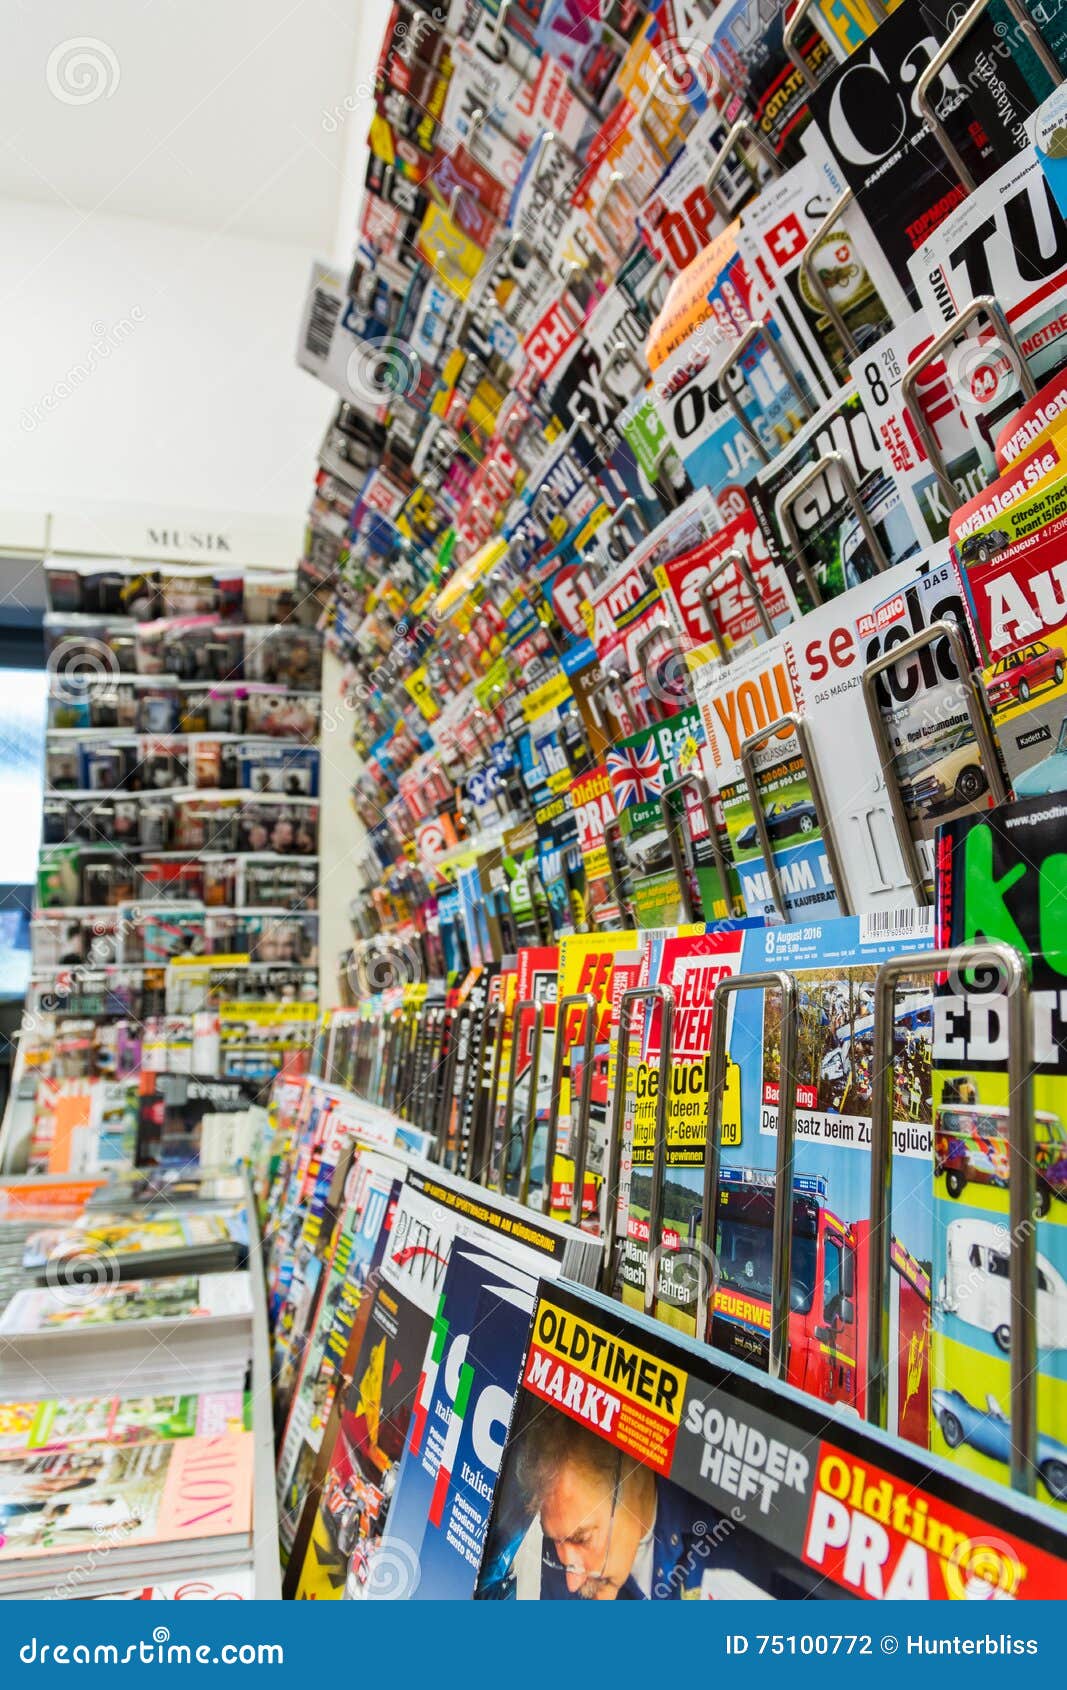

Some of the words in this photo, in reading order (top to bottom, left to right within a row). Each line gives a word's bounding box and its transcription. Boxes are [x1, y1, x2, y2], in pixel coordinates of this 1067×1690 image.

[881, 348, 896, 366] 20
[887, 363, 902, 379] 16
[864, 362, 890, 407] 8
[955, 478, 1028, 541] Wählen
[1023, 453, 1057, 489] Sie
[1011, 502, 1046, 526] Citroën
[1015, 515, 1042, 538] Avant
[147, 528, 232, 552] MUSIK
[990, 533, 1041, 567] JULI/AUGUST
[922, 569, 950, 591] DAS
[805, 627, 857, 681] se
[815, 692, 830, 705] DAS
[720, 786, 735, 801] 911
[632, 805, 650, 823] Cars
[764, 931, 775, 955] 8
[776, 930, 802, 947] August
[802, 926, 823, 941] 2016
[931, 989, 1067, 1064] EDI
[669, 1100, 700, 1118] Ideen
[824, 1118, 854, 1142] beim
[500, 1218, 512, 1232] AM
[511, 1221, 557, 1254] NÜRBURGRING
[538, 1309, 679, 1416] OLDTIMER
[526, 1351, 621, 1433] MARKT
[684, 1398, 810, 1496] SONDER
[700, 1441, 780, 1515] HEFT
[451, 1504, 475, 1534] Modica
[454, 1493, 482, 1525] Palermo
[449, 1516, 481, 1555] Zafferano
[818, 1455, 1028, 1598] Oldtimer
[446, 1529, 466, 1556] Santo
